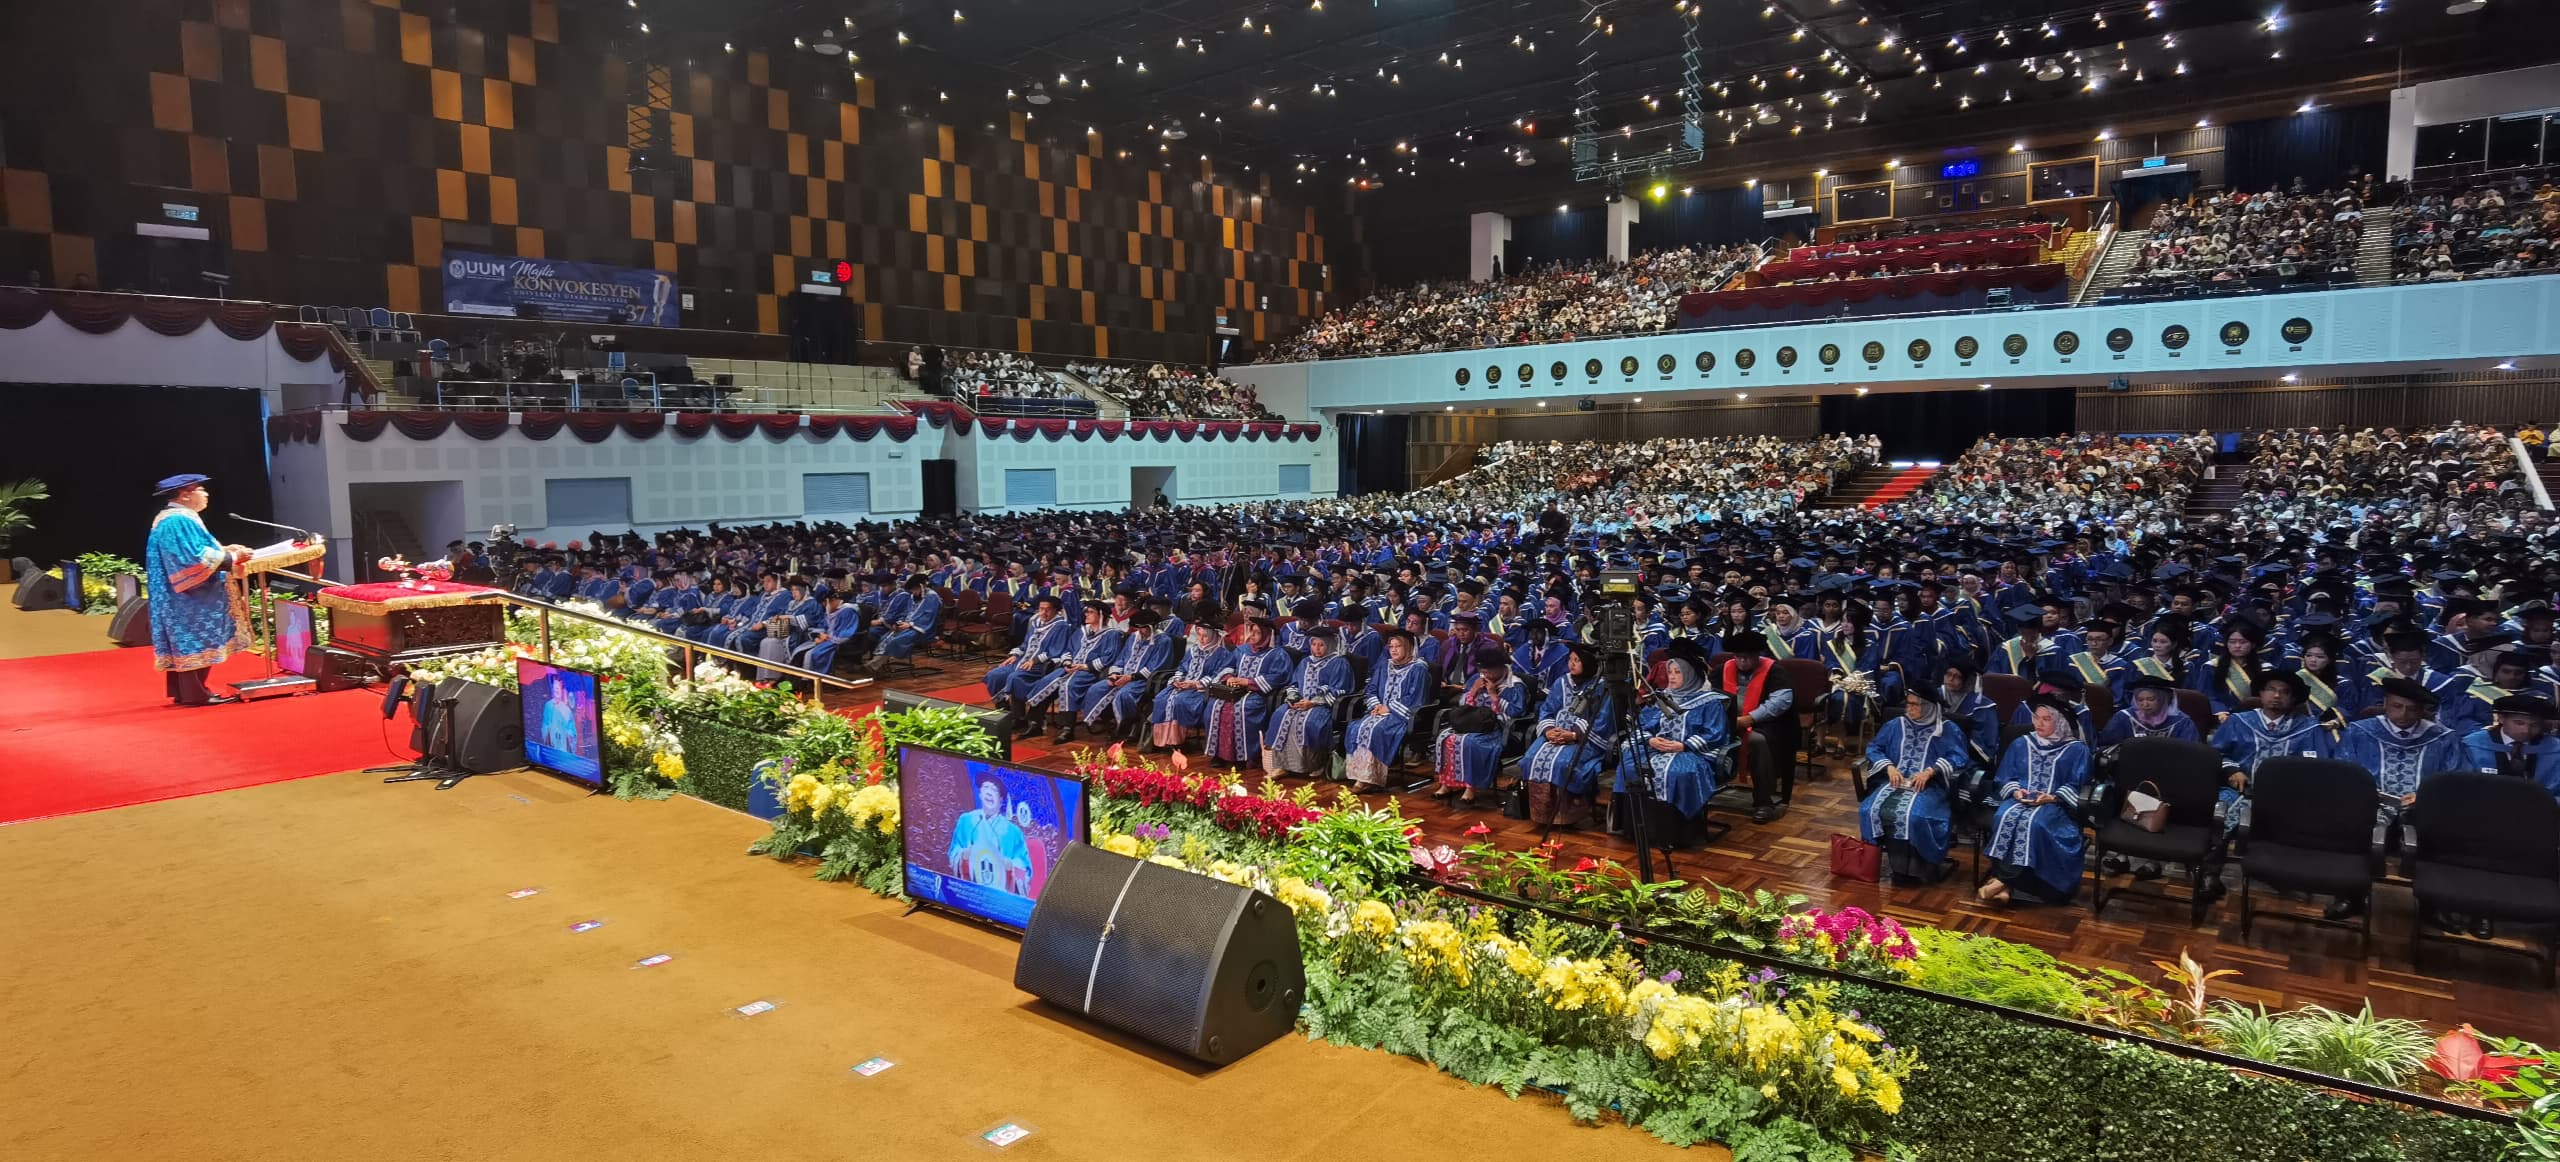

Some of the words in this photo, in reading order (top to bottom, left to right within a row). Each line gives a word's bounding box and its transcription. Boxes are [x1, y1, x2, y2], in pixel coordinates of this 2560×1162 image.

[466, 260, 505, 277] UUM
[510, 260, 556, 280] Majlis
[513, 275, 641, 299] KONVOKESYEN
[625, 304, 648, 322] 37
